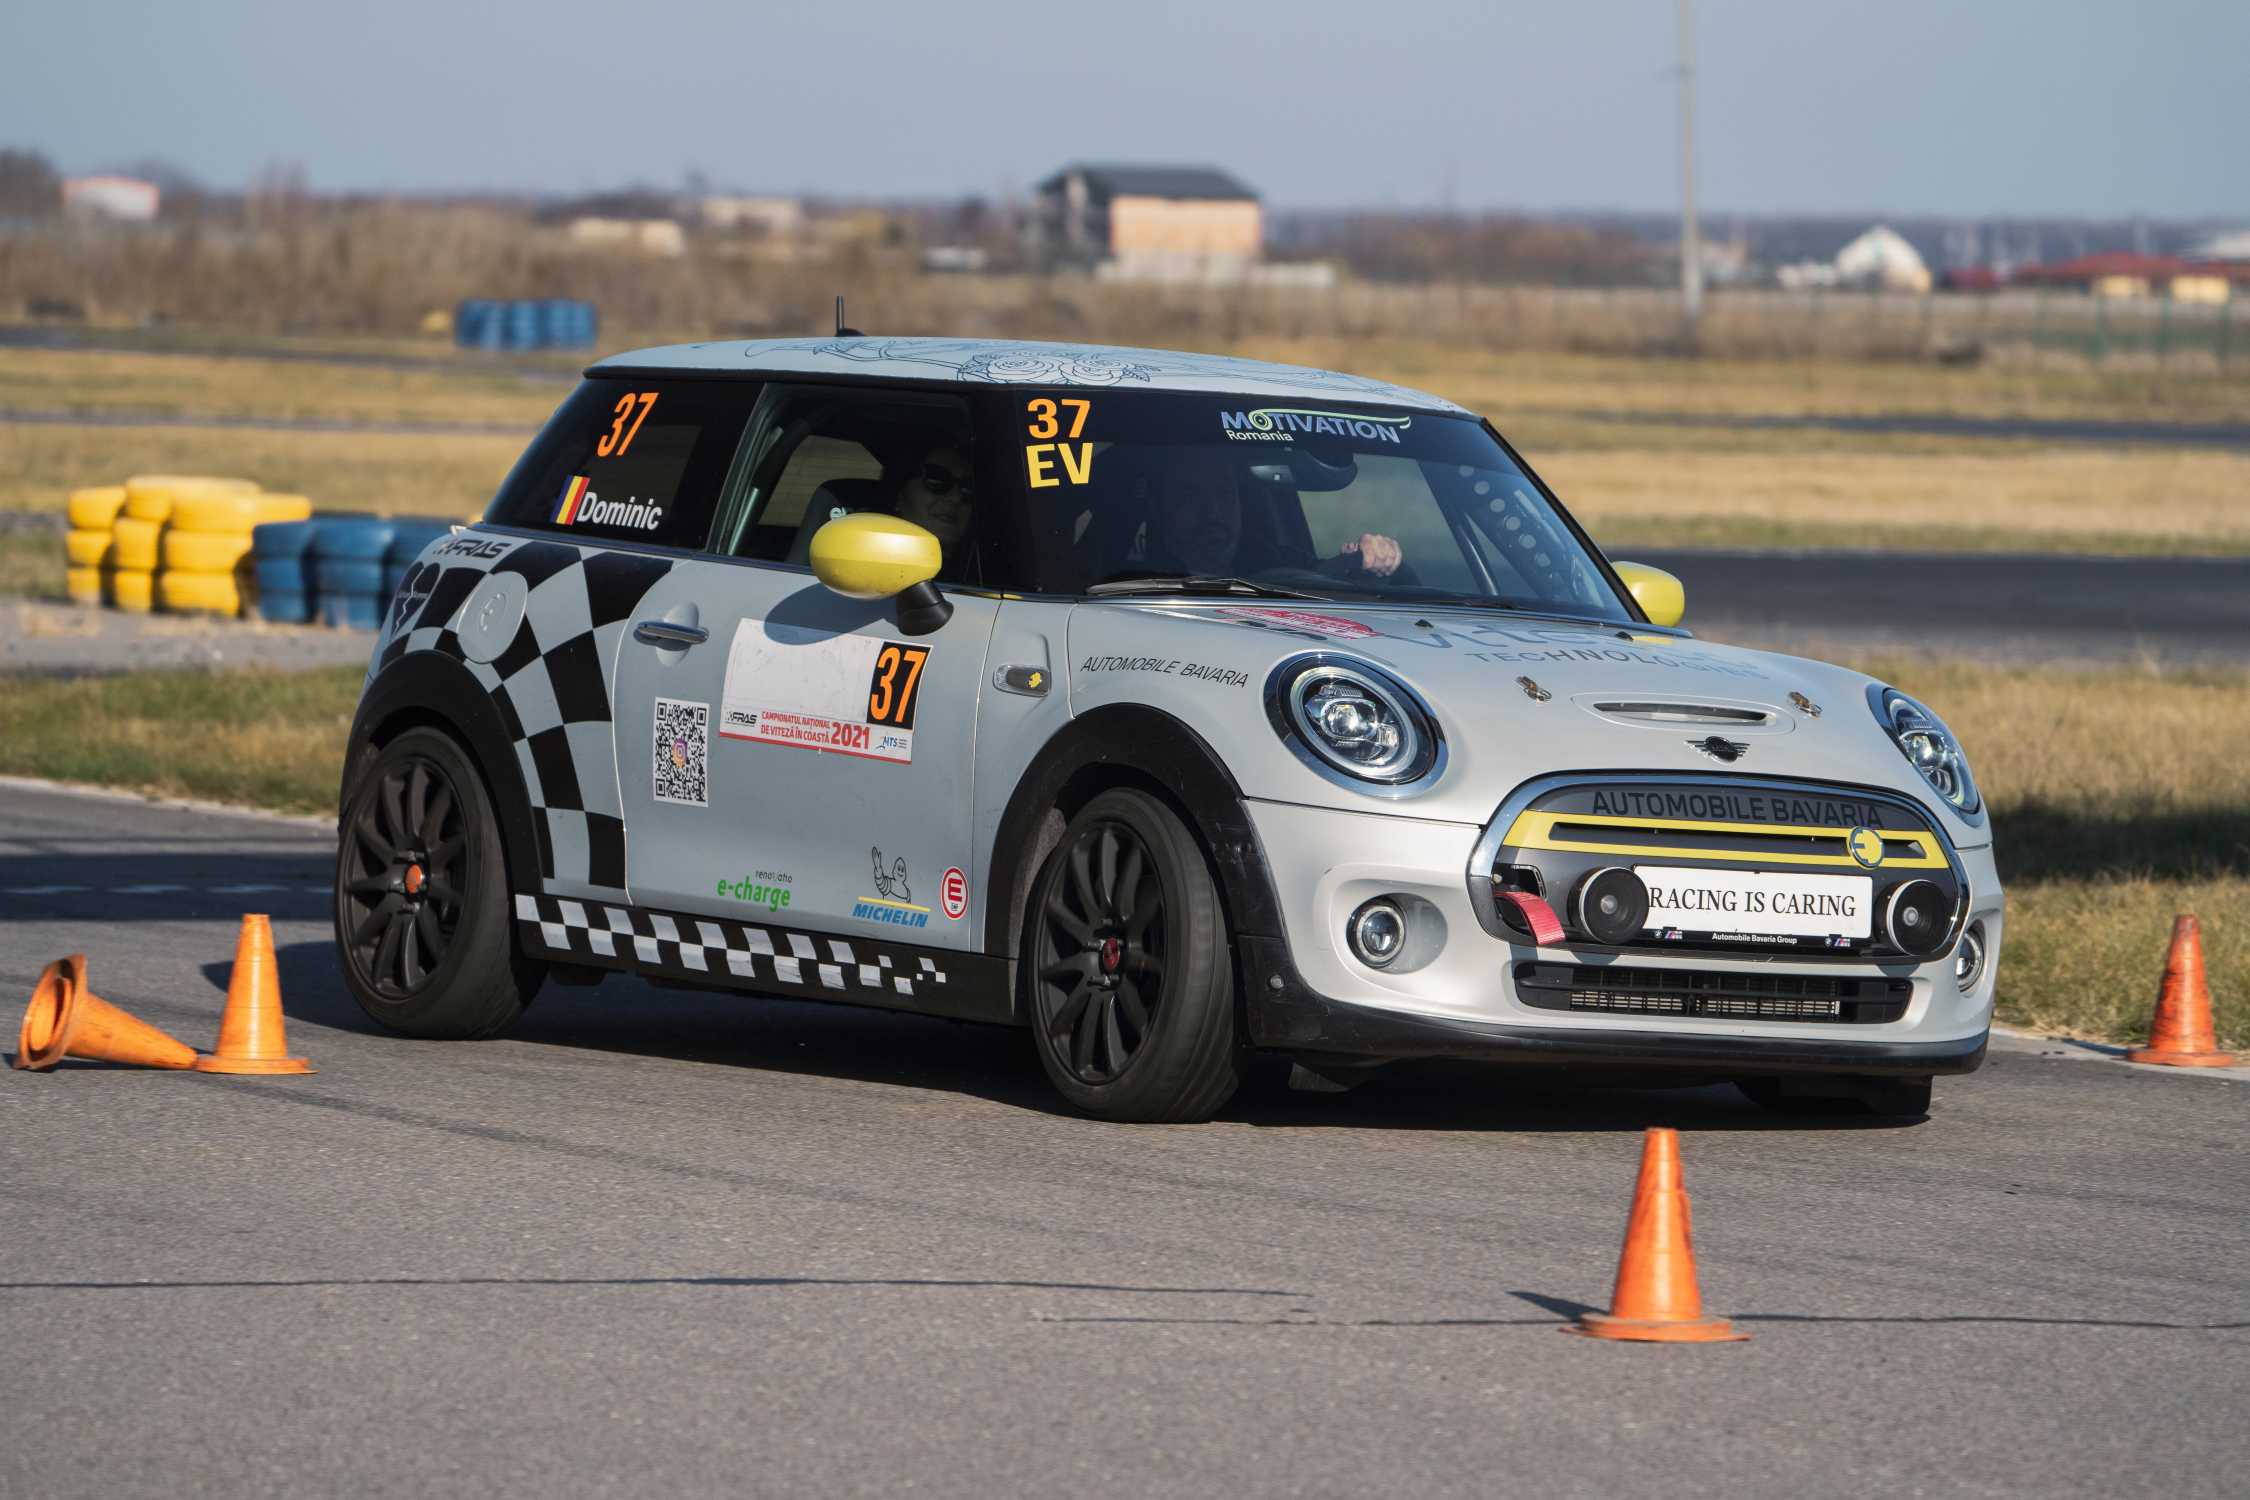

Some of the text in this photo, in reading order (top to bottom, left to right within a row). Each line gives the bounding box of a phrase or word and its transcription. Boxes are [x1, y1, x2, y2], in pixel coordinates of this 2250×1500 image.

[597, 392, 659, 457] 37
[1026, 398, 1091, 439] 37
[1220, 409, 1401, 444] MOTIVATION
[1226, 429, 1294, 442] Romania
[1026, 442, 1093, 488] EV
[577, 491, 662, 530] Dominic
[870, 647, 926, 723] 37
[1080, 656, 1249, 688] AUTOMOBILE BAVARIA
[761, 724, 769, 735] DE
[762, 711, 801, 725] CAMPIONATUL
[831, 722, 870, 750] 2021
[1592, 791, 1883, 828] AUTOMOBILE BAVARIA
[717, 876, 791, 912] e-charge
[1649, 886, 1856, 917] RACING IS CARING
[852, 903, 928, 928] MICHELIN
[1711, 932, 1797, 945] Automobile Bavaria Group
